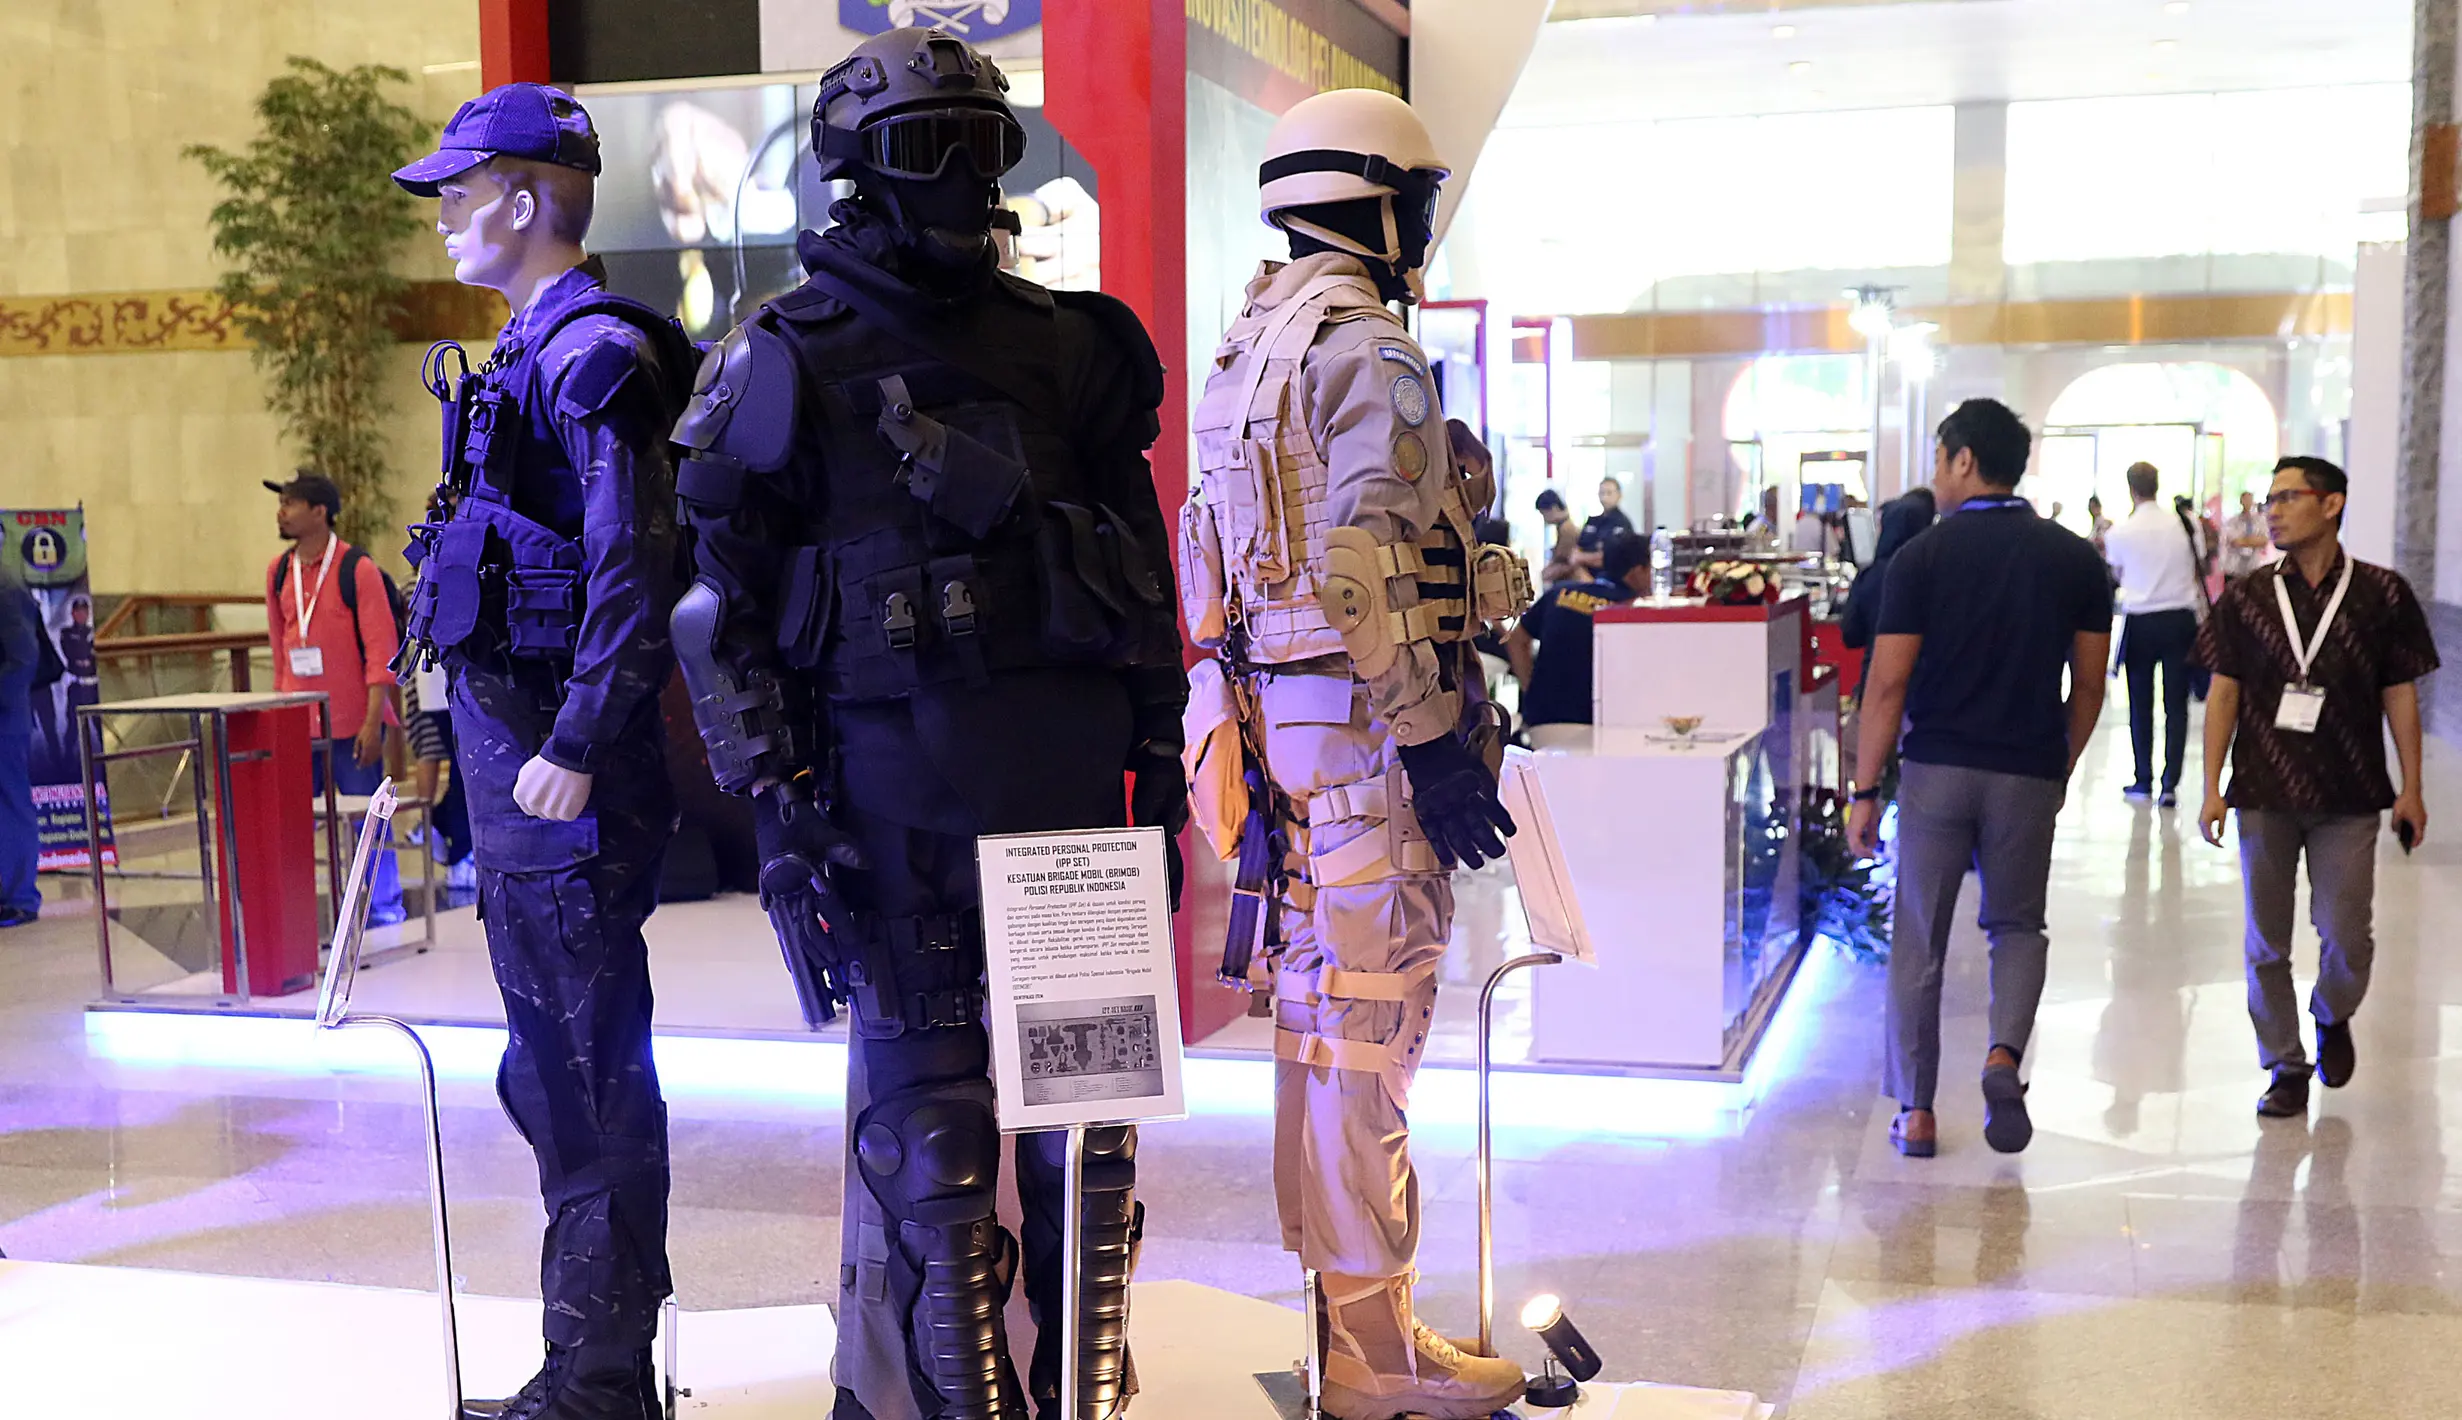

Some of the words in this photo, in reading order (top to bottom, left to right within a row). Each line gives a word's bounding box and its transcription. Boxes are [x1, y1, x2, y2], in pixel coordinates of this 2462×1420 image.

[1384, 349, 1421, 372] UNAMID
[1006, 846, 1050, 857] INTEGRATED
[1053, 844, 1090, 855] PERSONAL
[1092, 841, 1136, 853] PROTECTION
[1056, 859, 1071, 868] (IPP
[1074, 857, 1090, 867] SET)
[1007, 872, 1046, 883] KESATUAN
[1048, 871, 1079, 881] BRIGADE
[1081, 869, 1103, 879] MOBIL
[1106, 867, 1139, 878] (BRIMOB)
[1024, 886, 1048, 895] POLISI
[1050, 884, 1085, 894] REPUBLIK
[1087, 881, 1126, 892] INDONESIA
